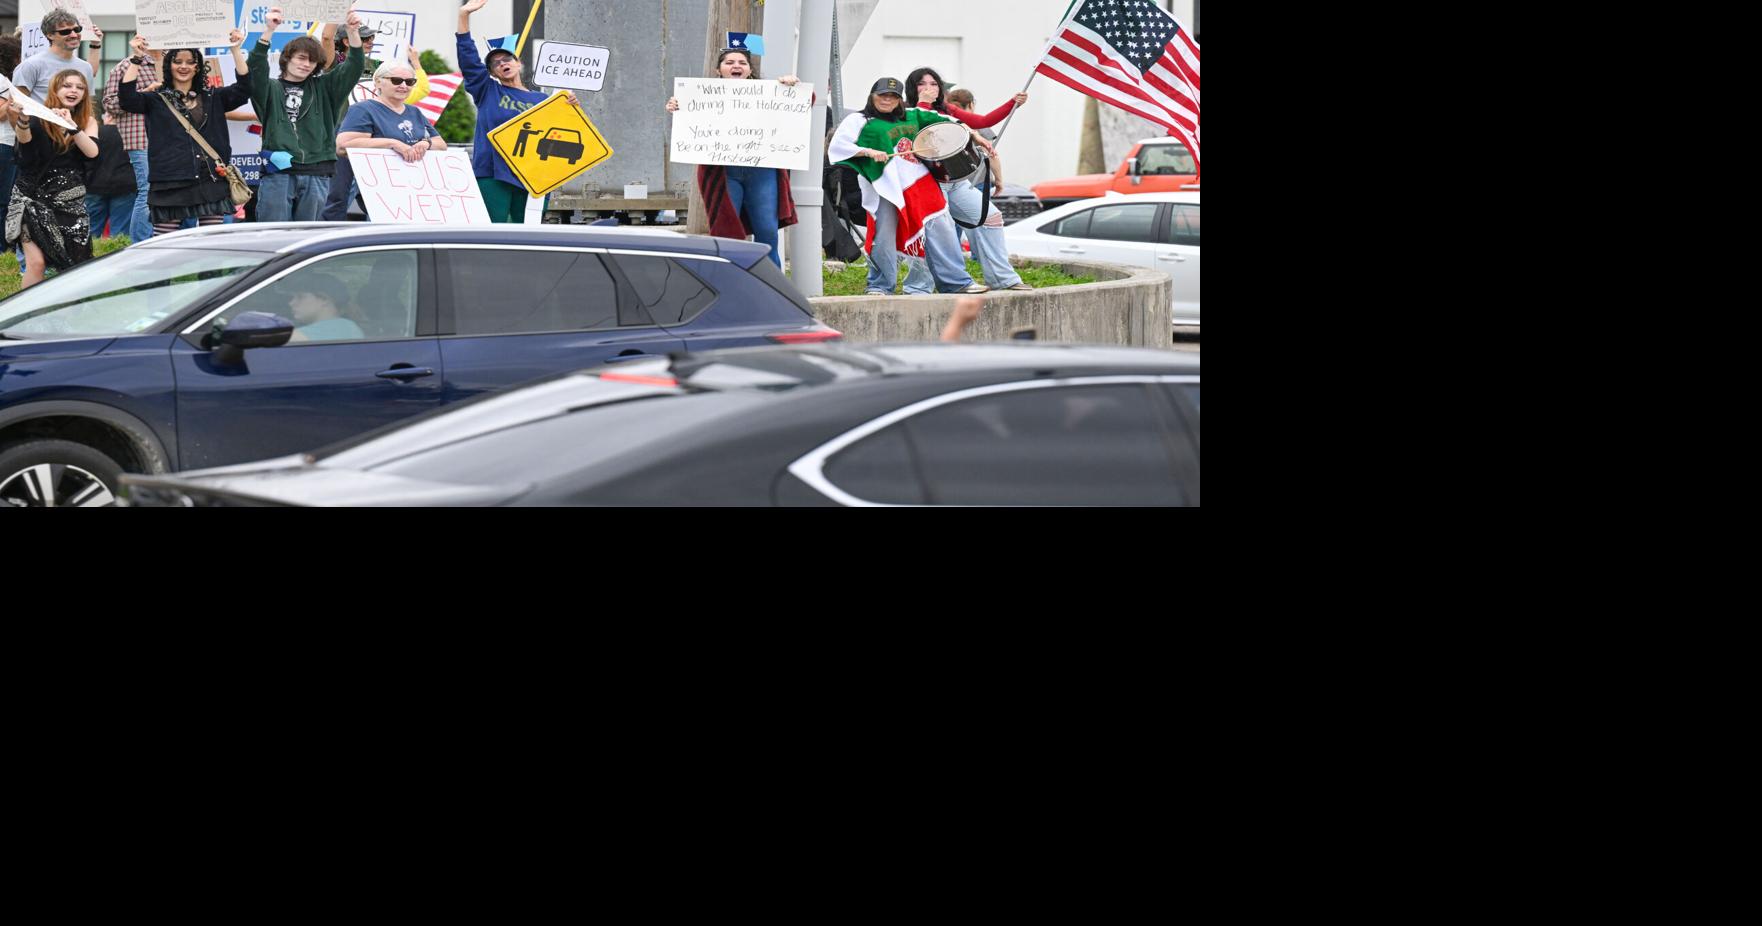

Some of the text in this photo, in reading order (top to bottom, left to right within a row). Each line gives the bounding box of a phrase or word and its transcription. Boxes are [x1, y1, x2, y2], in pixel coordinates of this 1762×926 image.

[548, 54, 600, 67] CAUTION
[541, 65, 602, 80] ICE AHEAD
[732, 84, 763, 96] would
[782, 87, 797, 98] do
[687, 99, 725, 115] during
[731, 98, 752, 109] The
[727, 125, 764, 140] doing
[676, 141, 692, 152] Be
[693, 144, 709, 152] on
[713, 141, 732, 152] the
[736, 140, 763, 154] right
[231, 157, 262, 167] DEVELO
[351, 152, 471, 193] JESUS
[375, 192, 478, 225] WEPT
